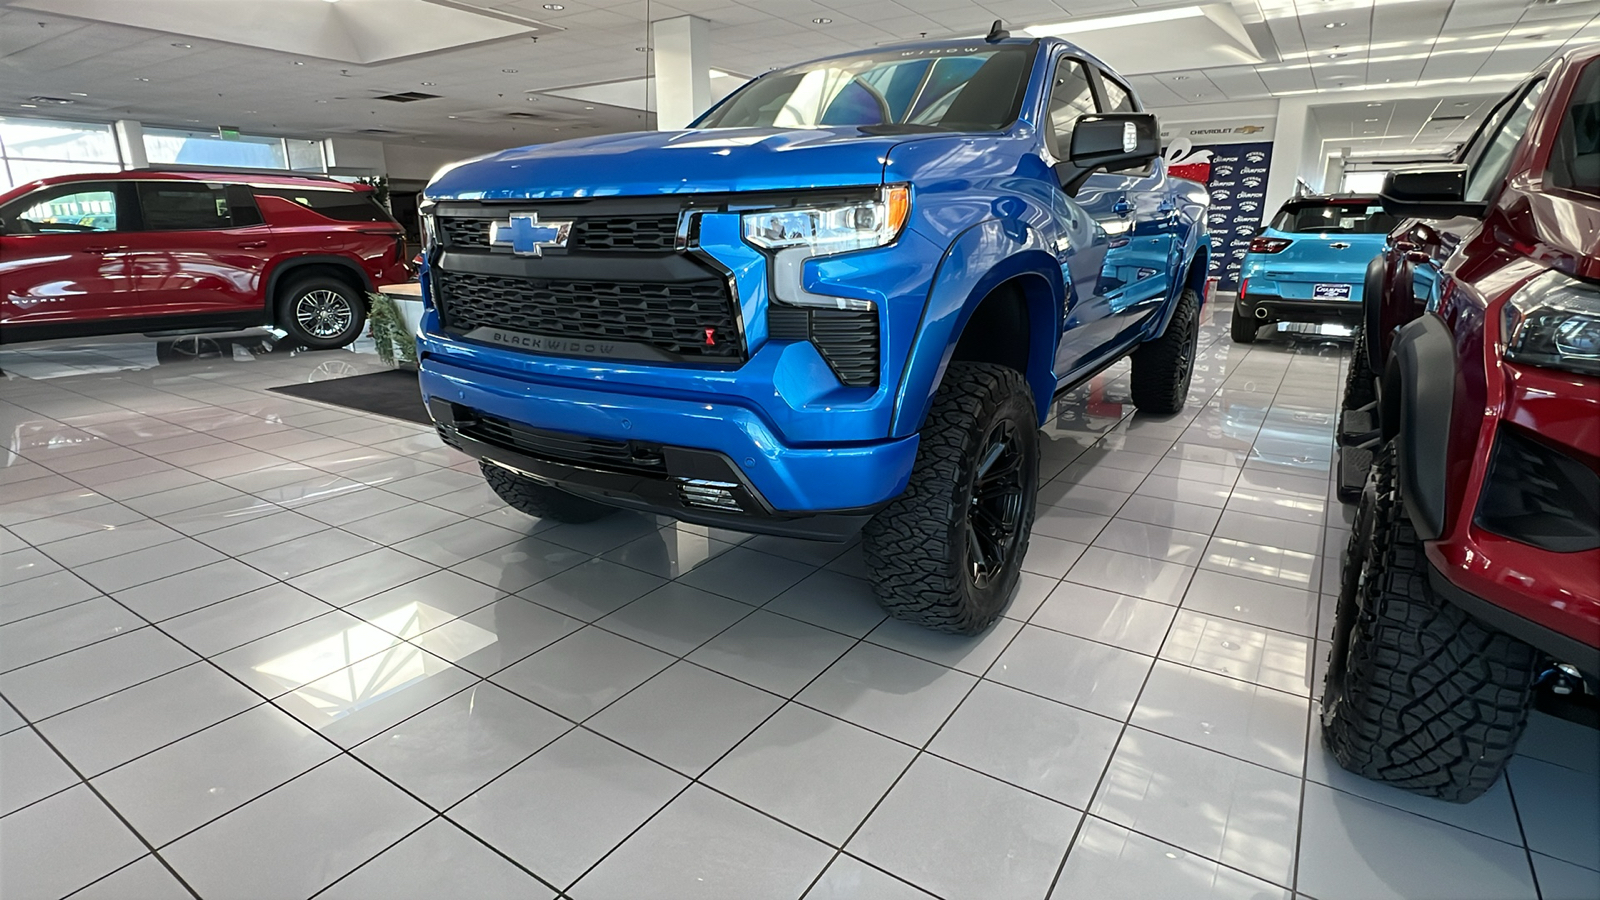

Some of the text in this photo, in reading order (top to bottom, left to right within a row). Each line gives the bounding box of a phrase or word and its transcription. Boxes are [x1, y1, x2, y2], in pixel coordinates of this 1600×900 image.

[901, 47, 979, 56] WIDOW
[1190, 127, 1233, 135] CHEVROLET
[1316, 286, 1349, 294] CHAMPION
[493, 332, 615, 354] BLACK WIDOW
